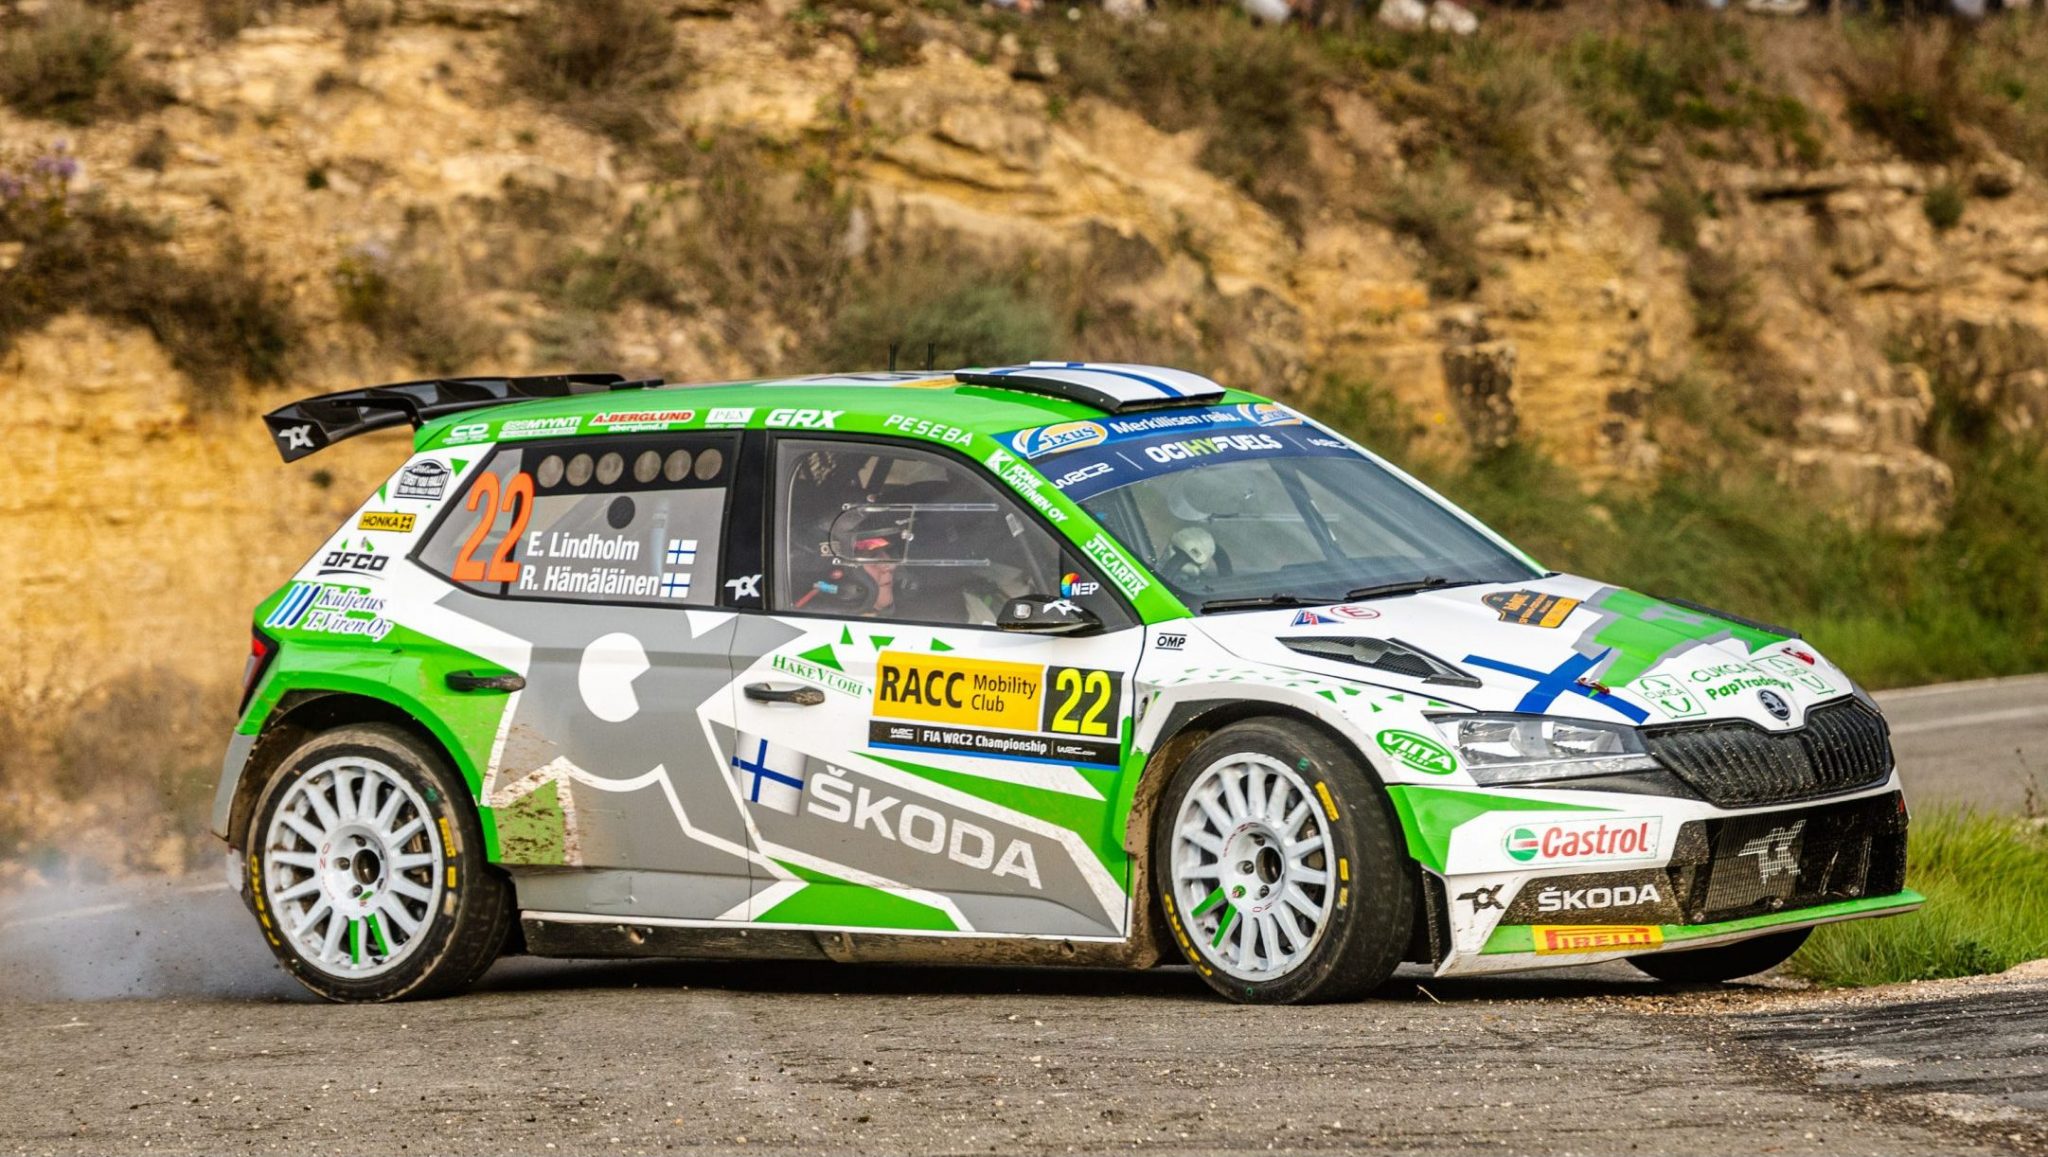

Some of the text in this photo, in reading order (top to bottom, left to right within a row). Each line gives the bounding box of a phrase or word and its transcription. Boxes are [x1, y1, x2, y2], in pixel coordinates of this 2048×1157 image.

[593, 411, 692, 424] A.BERGLUND
[765, 408, 844, 429] GRX
[883, 414, 973, 447] PESEBA
[1109, 413, 1203, 434] Merkillisen
[1011, 464, 1043, 488] KONE
[1050, 462, 1115, 489] WRC2
[1002, 469, 1069, 523] LAHTINEN OY
[361, 515, 398, 527] HONKA
[452, 471, 535, 582] 22
[527, 531, 640, 561] E. Lindholm
[520, 565, 660, 596] R. Hämäläinen
[1071, 582, 1100, 596] NEP
[319, 587, 386, 611] Kuljetus
[1157, 635, 1187, 648] OMP
[879, 665, 1037, 709] RACC Mobility
[971, 694, 1005, 713] Club
[1051, 667, 1112, 736] 22
[923, 730, 941, 743] FIA
[942, 731, 973, 746] WRC2
[975, 735, 1047, 755] Championship
[806, 764, 1043, 890] ŠKODA
[1541, 822, 1649, 859] Castrol
[1537, 883, 1661, 912] ŠKODA
[1545, 927, 1651, 950] PIRELLI
